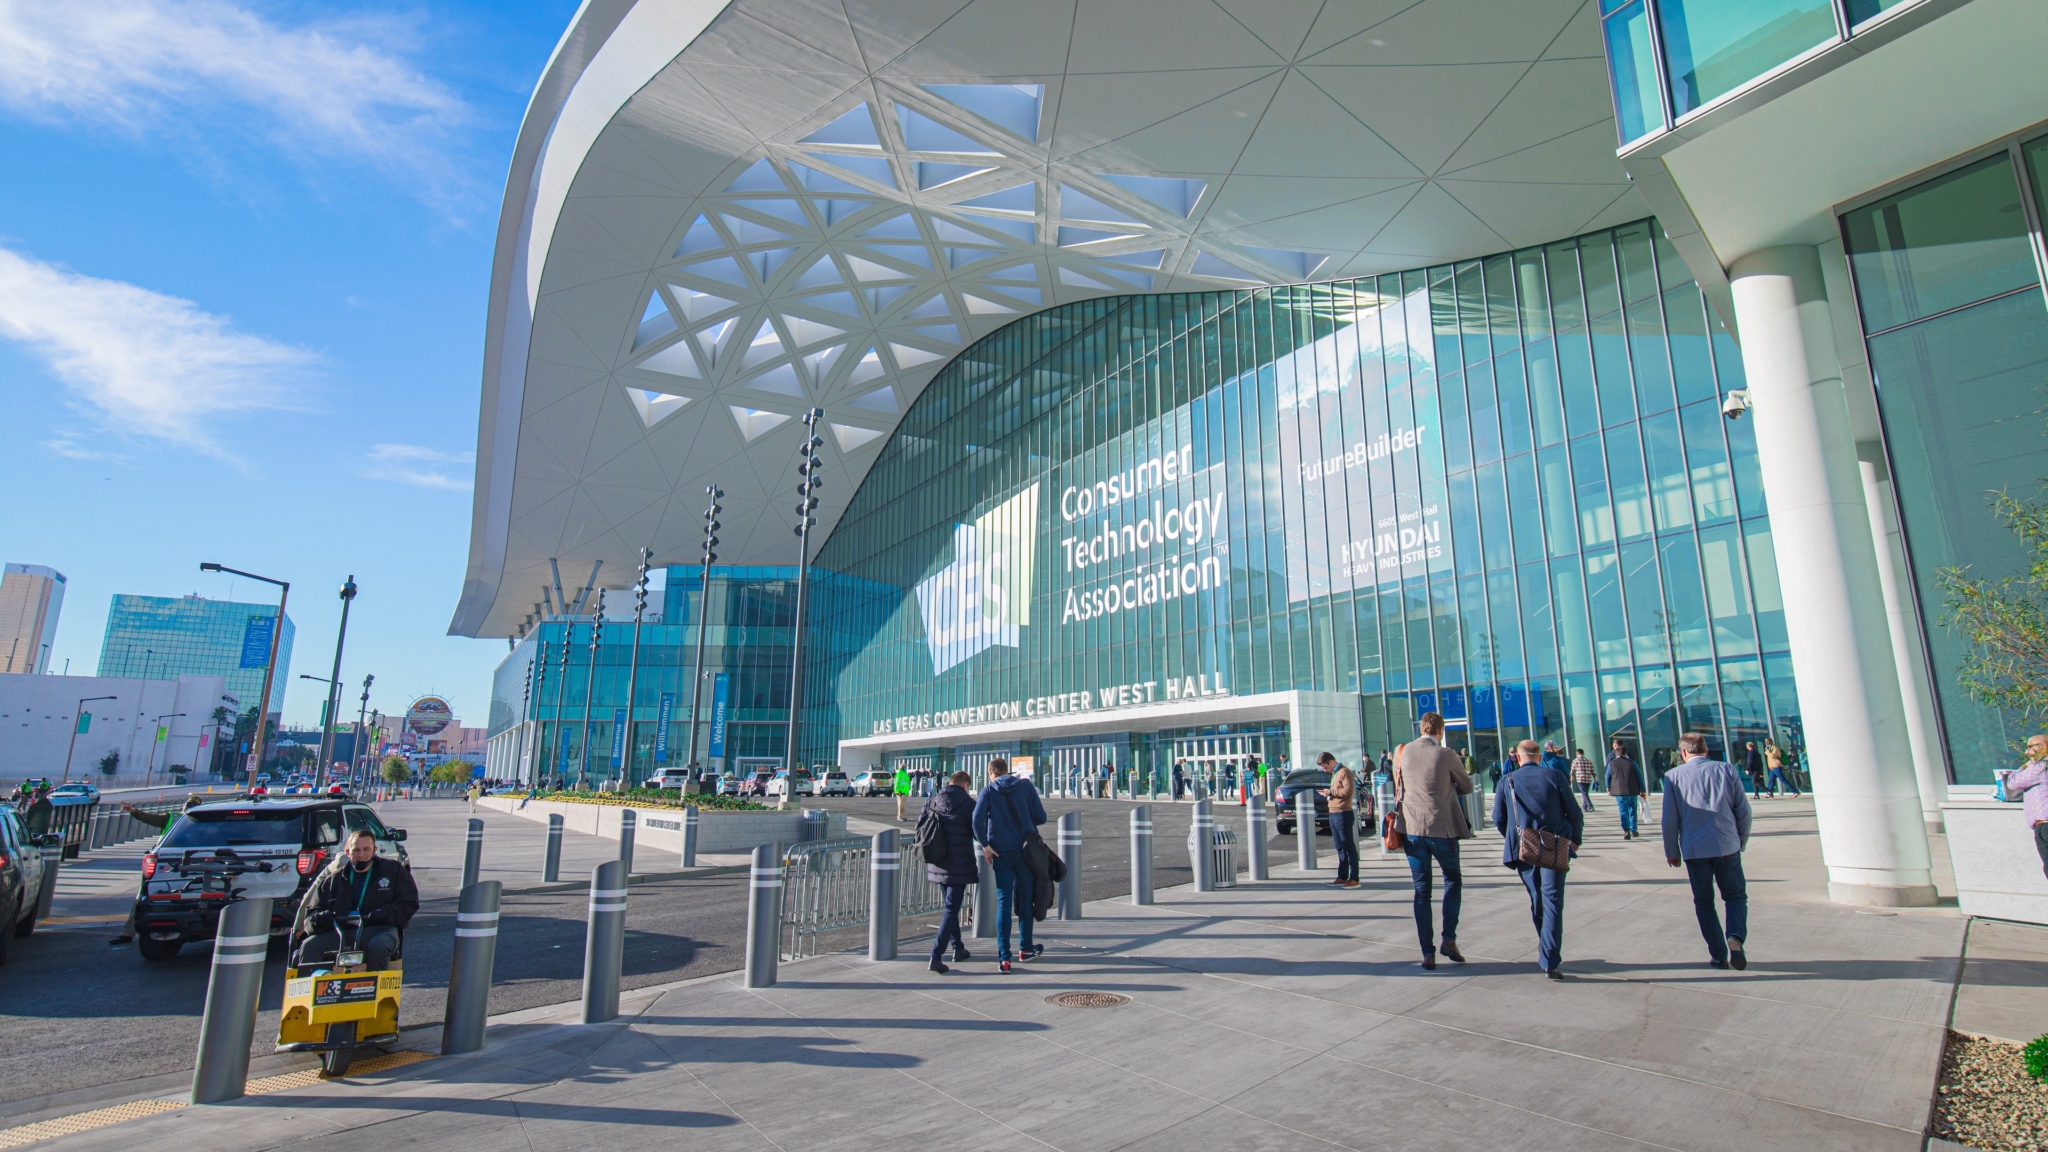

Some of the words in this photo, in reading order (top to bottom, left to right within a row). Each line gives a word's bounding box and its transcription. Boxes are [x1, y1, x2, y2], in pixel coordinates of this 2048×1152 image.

[1297, 425, 1425, 484] FutureBuilder
[1062, 443, 1192, 521] Consumer
[1062, 492, 1223, 573] Technology
[1378, 516, 1396, 528] 6605
[1399, 511, 1419, 523] West
[1423, 504, 1438, 516] Hall
[1341, 520, 1440, 564] HYUNDAI
[1343, 561, 1375, 577] HEAVY
[1380, 546, 1441, 569] INDUSTRES
[930, 550, 1007, 647] CES
[1062, 555, 1221, 625] Association
[874, 719, 893, 734] LAS
[895, 713, 930, 732] VEGAS
[934, 700, 1021, 727] CONVENTION
[1026, 690, 1092, 716] CENTER
[1100, 681, 1157, 708] WEST
[1166, 672, 1229, 699] HALL
[1475, 686, 1512, 703] 676
[613, 723, 622, 758] Bienvenue
[658, 701, 670, 751] Willkommen
[713, 701, 724, 744] Welcome
[316, 980, 341, 996] H&E
